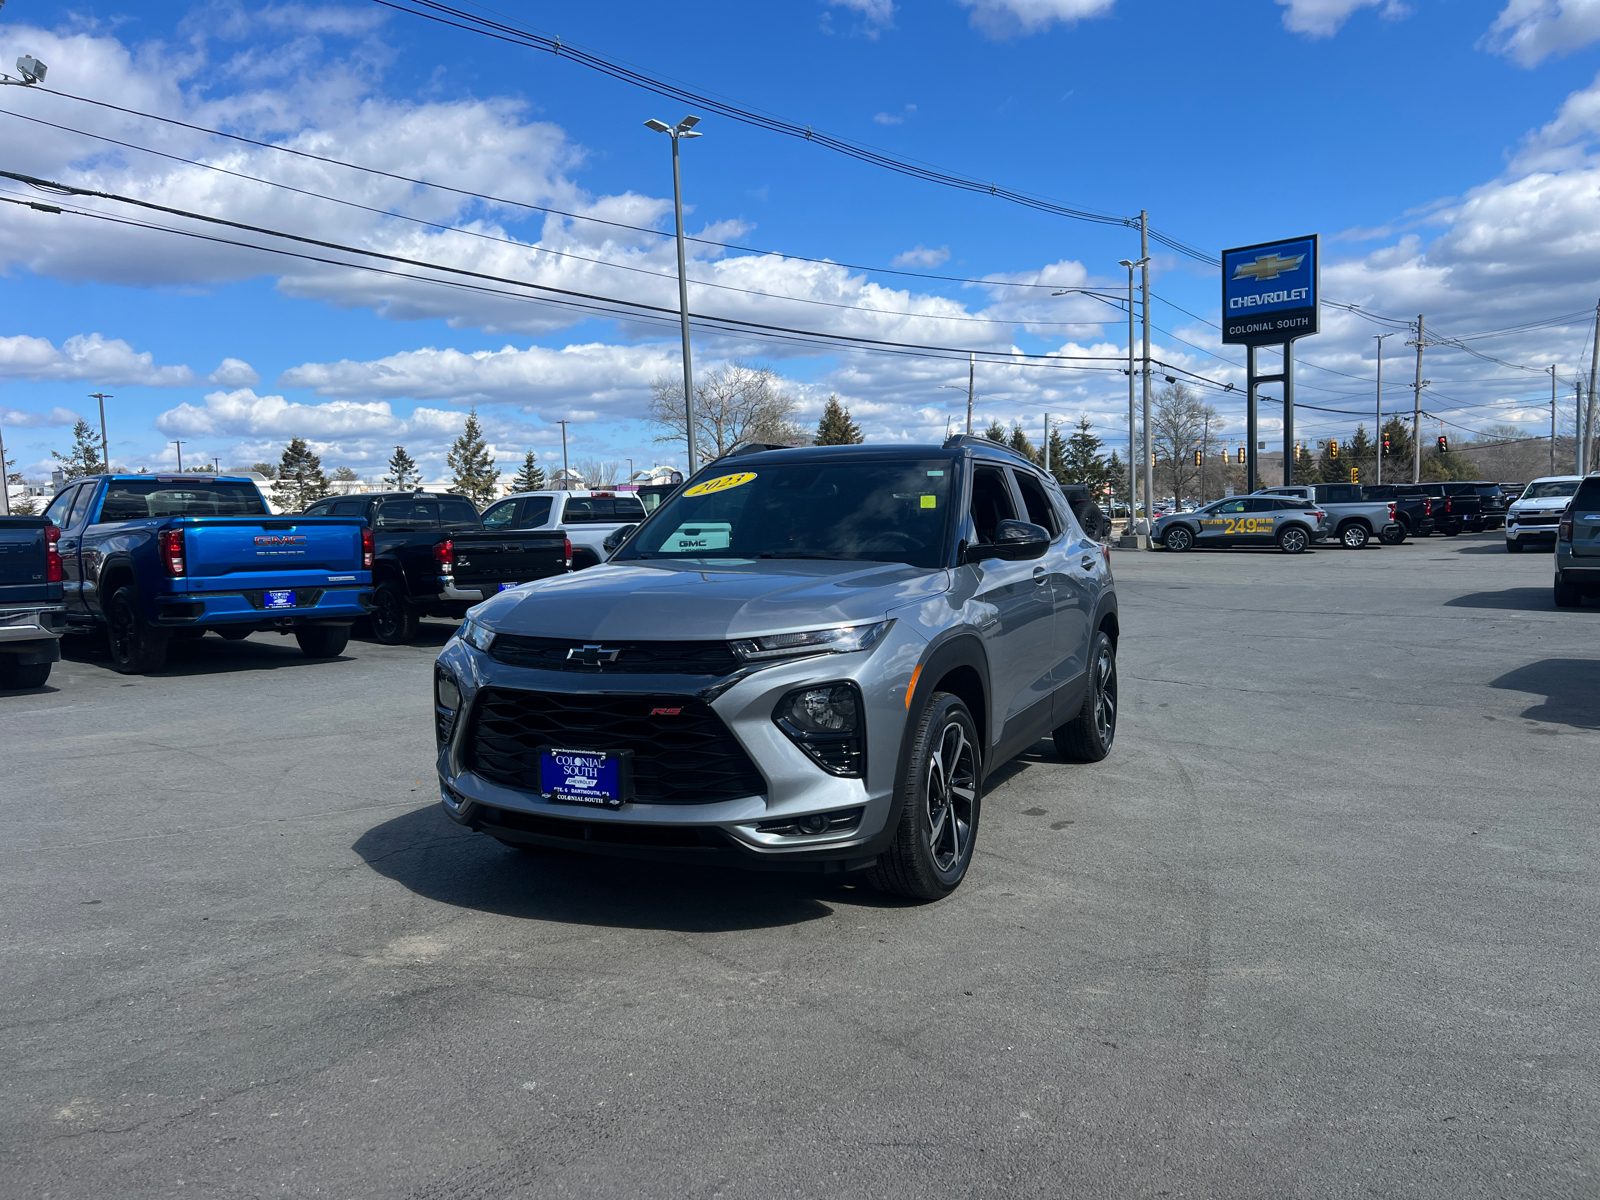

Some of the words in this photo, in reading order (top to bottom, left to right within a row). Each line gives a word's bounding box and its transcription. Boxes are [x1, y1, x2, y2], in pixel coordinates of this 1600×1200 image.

[1230, 287, 1308, 308] CHEVROLET
[1229, 322, 1273, 335] COLONIAL
[1277, 317, 1309, 329] SOUTH
[692, 474, 745, 494] 2023
[254, 535, 306, 546] GMC
[650, 707, 682, 716] RS
[556, 756, 605, 768] COLONIAL
[563, 766, 598, 778] SOUTH
[568, 778, 595, 786] CHEVROLET
[557, 794, 584, 802] COLONIAL
